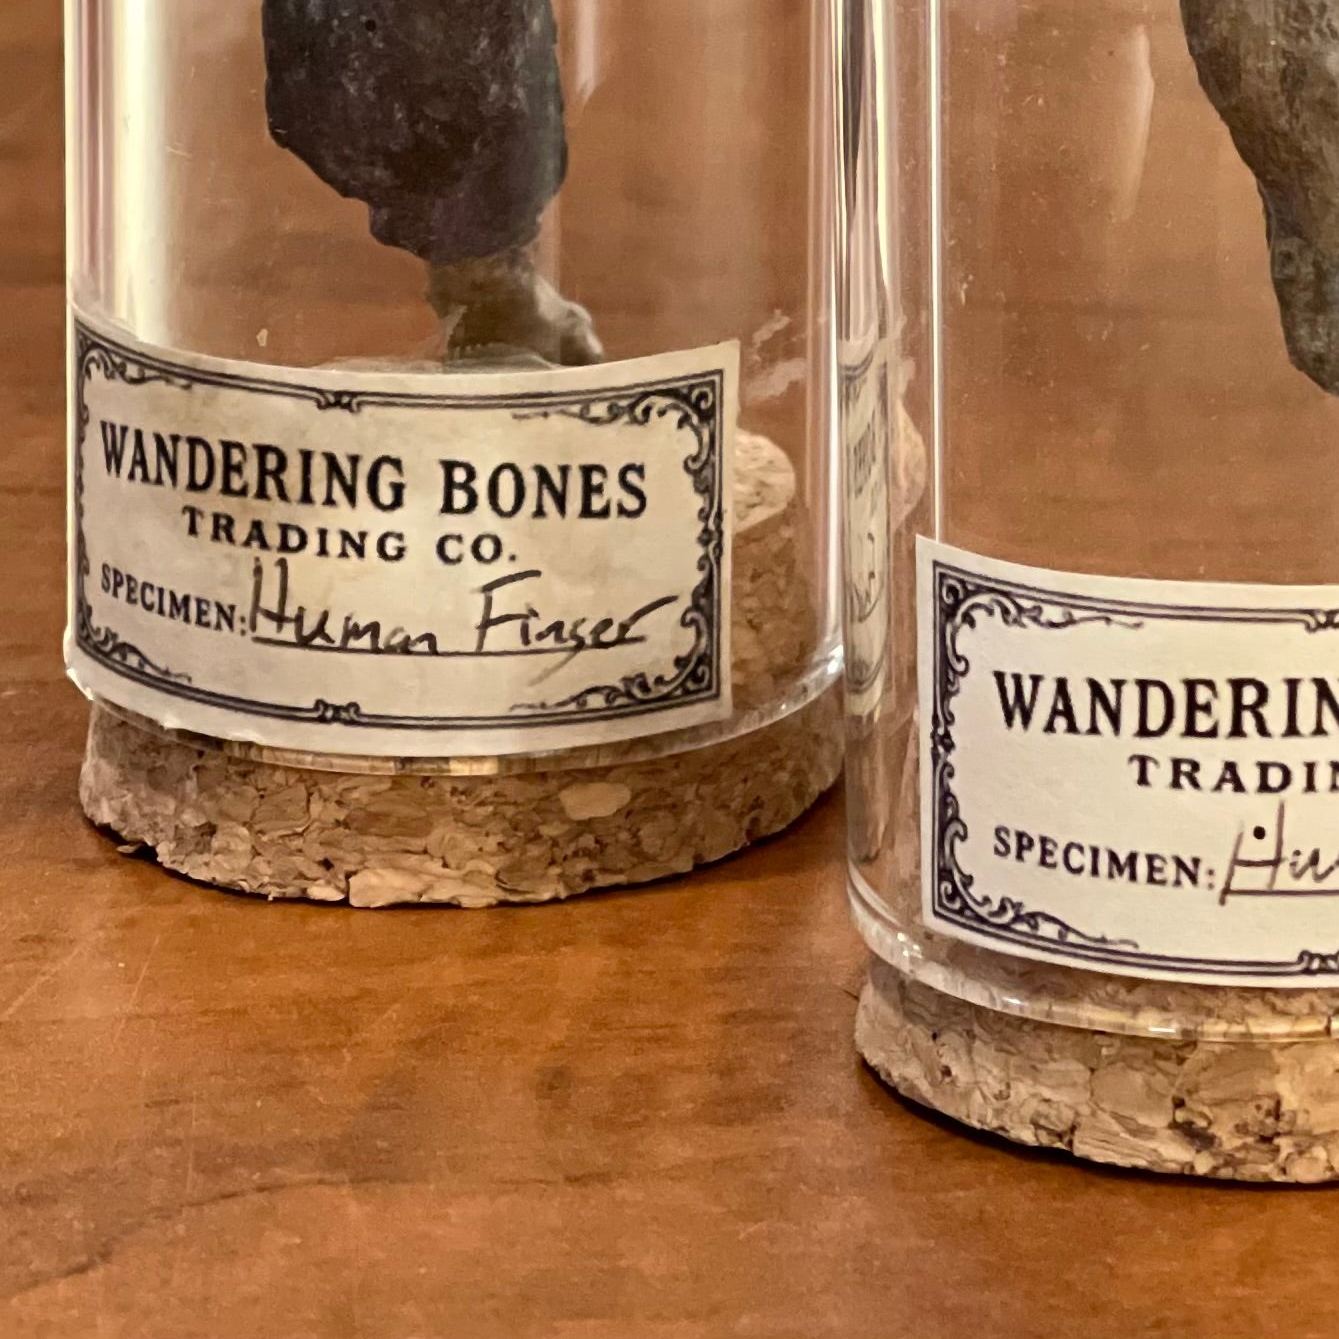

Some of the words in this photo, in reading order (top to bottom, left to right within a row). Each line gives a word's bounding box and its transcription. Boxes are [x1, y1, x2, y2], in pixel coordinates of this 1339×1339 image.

[100, 419, 407, 511] WANDERING
[439, 460, 648, 519] BONES
[182, 505, 407, 562] TRADING
[436, 533, 518, 564] CO.
[100, 562, 248, 635] SPECIMEN:
[249, 557, 438, 655] Human
[992, 825, 1215, 889] SPECIMEN:
